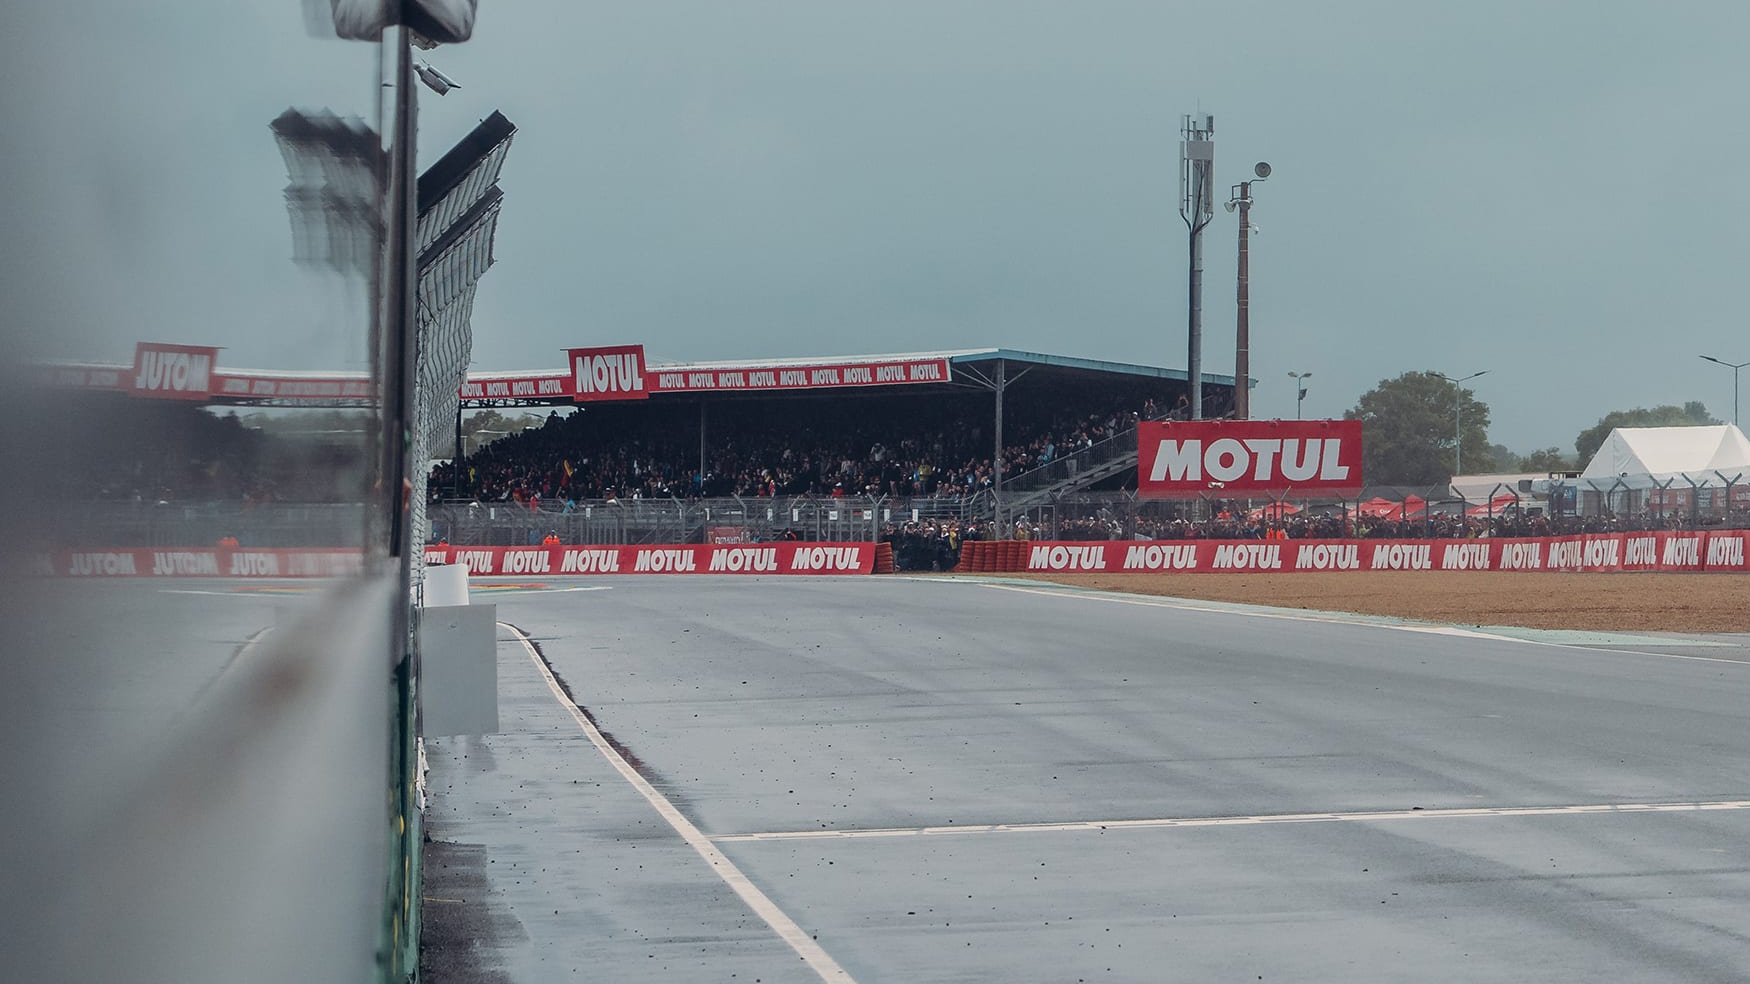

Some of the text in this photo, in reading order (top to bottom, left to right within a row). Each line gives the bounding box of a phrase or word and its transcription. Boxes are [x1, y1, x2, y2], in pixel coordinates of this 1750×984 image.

[487, 382, 509, 396] MOTUL
[512, 381, 535, 395] MOTUL
[538, 379, 563, 394] MOTUL
[576, 353, 643, 394] MOTUL
[659, 363, 940, 389] MOTUL MOTUL MOTUL MOTUL MOTUL MOTUL MOTUL MOTUL MOTUL
[1149, 437, 1350, 482] MOTUL
[455, 550, 493, 574] MOTUL
[501, 550, 551, 574] MOTUL
[561, 549, 619, 573] MOTUL
[634, 549, 696, 572] MOTUL
[709, 548, 777, 572] MOTUL
[791, 547, 861, 571] MOTUL
[1028, 545, 1106, 570] MOTUL
[1124, 545, 1197, 570] MOTUL
[1212, 544, 1282, 569] MOTUL
[1295, 544, 1360, 569] MOTUL
[1372, 544, 1432, 569] MOTUL
[1442, 544, 1490, 569] MOTUL
[1500, 542, 1541, 569] MOTUL
[1547, 541, 1582, 568] MOTUL
[1583, 539, 1619, 566] MOTUL
[1624, 537, 1656, 565] MOTUL
[1662, 537, 1699, 565] MOTUL
[1707, 536, 1744, 566] MOTUL
